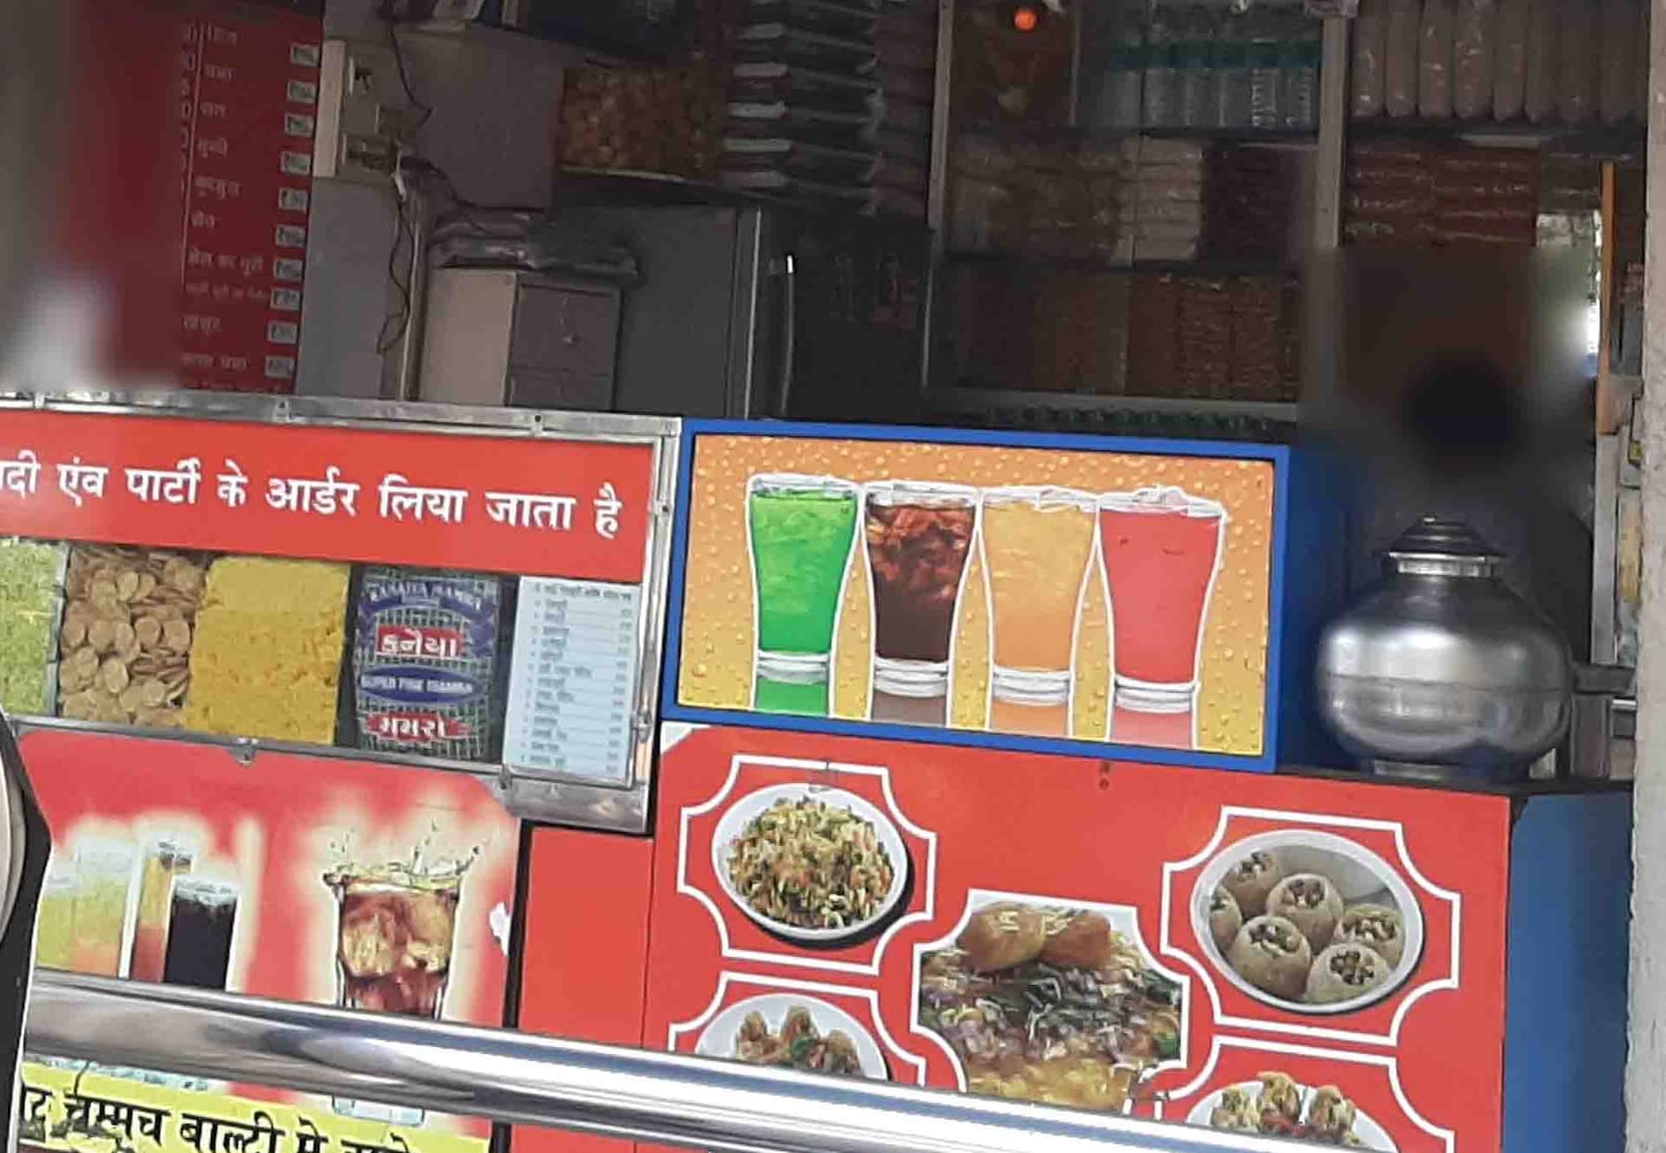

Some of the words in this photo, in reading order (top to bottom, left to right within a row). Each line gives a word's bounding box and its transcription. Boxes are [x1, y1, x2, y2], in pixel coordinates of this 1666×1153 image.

[56, 456, 109, 506] एंव
[127, 457, 202, 506] पार्टी
[217, 459, 247, 507] के
[265, 466, 360, 517] आर्डर
[379, 473, 468, 525] लिया
[485, 491, 576, 531] जाता
[593, 483, 624, 539] है
